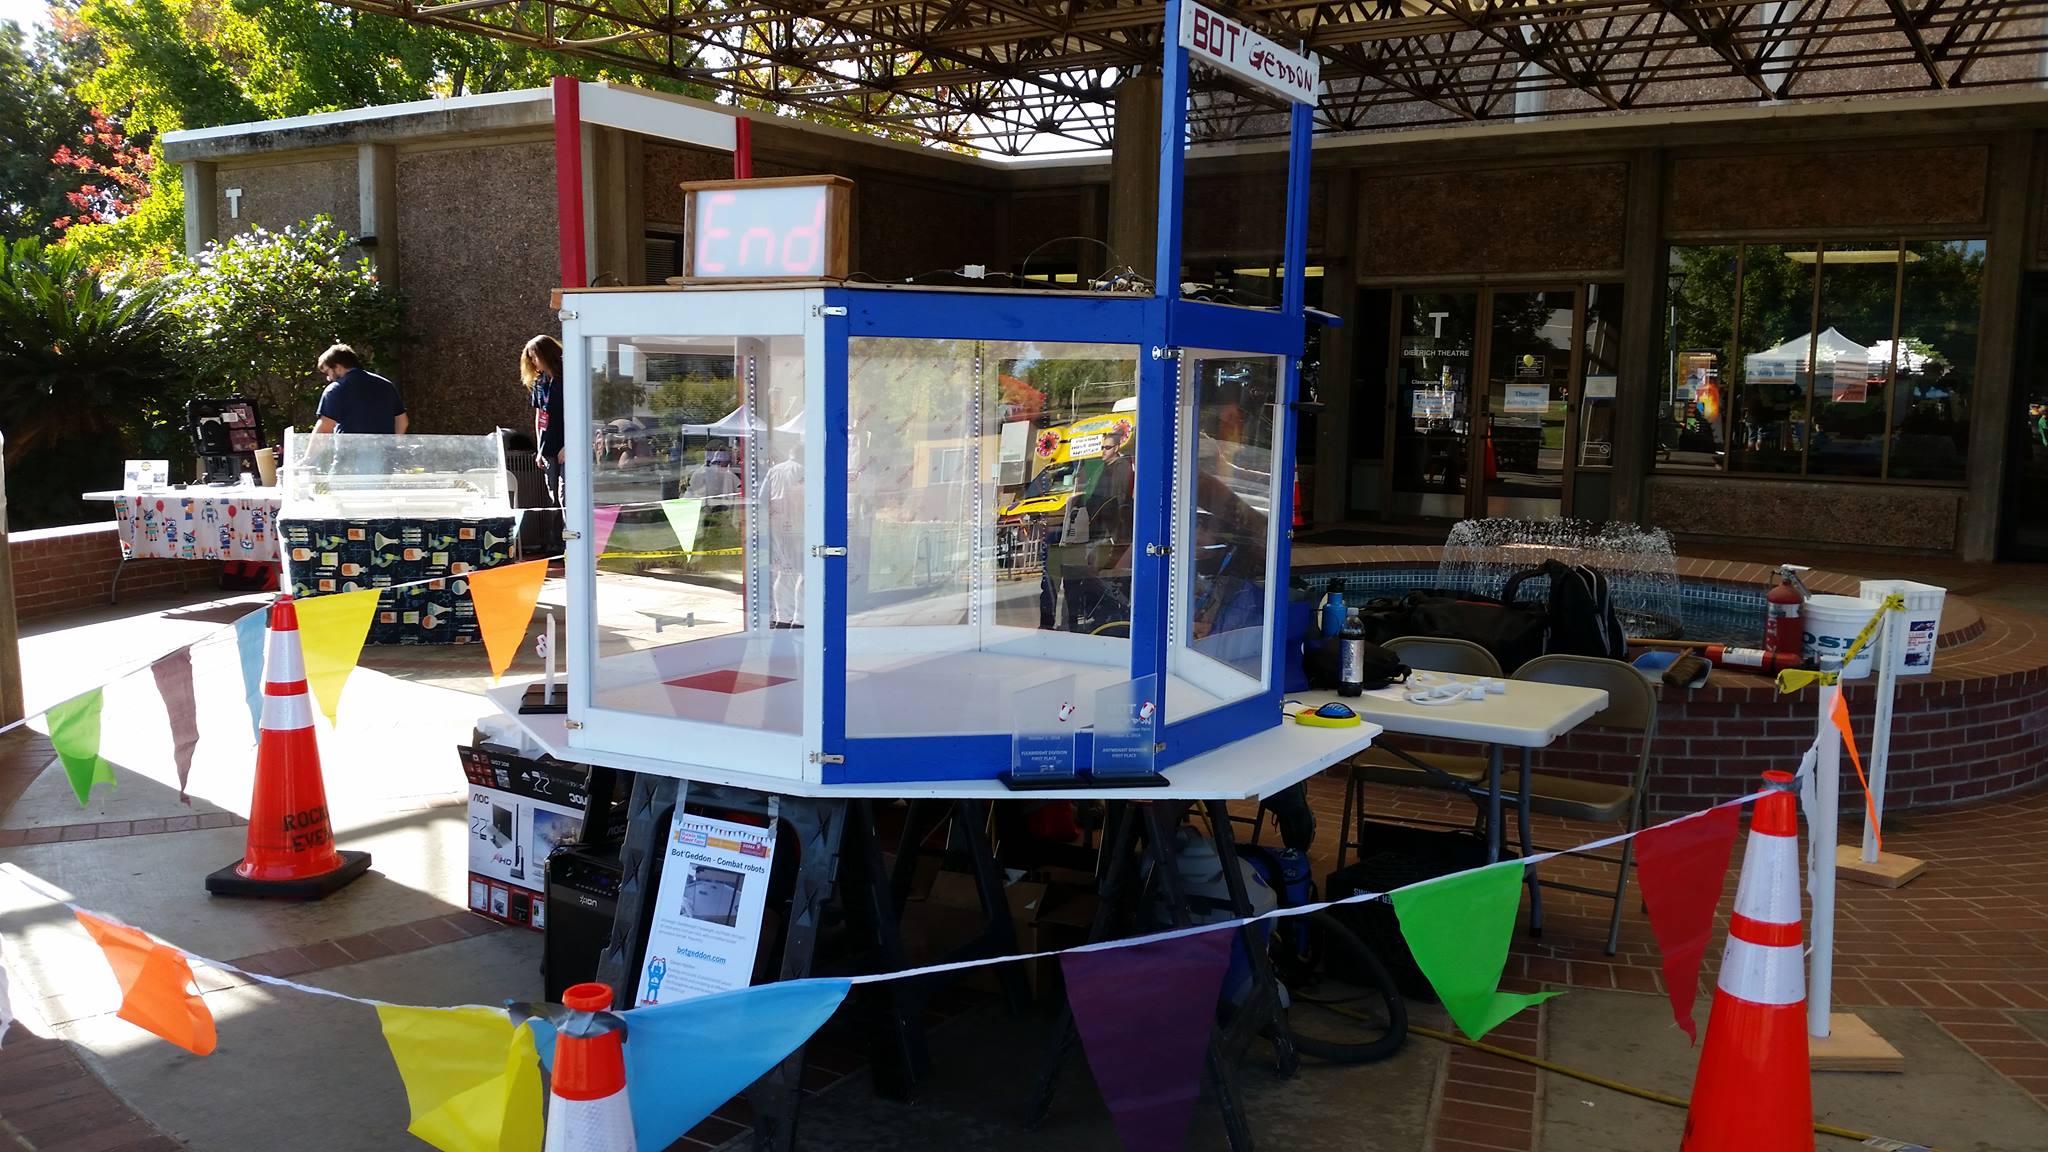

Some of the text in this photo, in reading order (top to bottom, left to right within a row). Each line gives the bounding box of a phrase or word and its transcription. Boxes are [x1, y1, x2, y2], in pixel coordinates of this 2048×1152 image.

[225, 188, 242, 219] T
[701, 193, 826, 273] End
[1428, 312, 1449, 338] T
[1437, 349, 1470, 357] THEATRE
[473, 793, 490, 805] AOC
[671, 848, 712, 863] Bot'Geddon
[716, 857, 743, 869] Combat
[744, 863, 765, 874] robots
[677, 946, 726, 964] botgeddon.com
